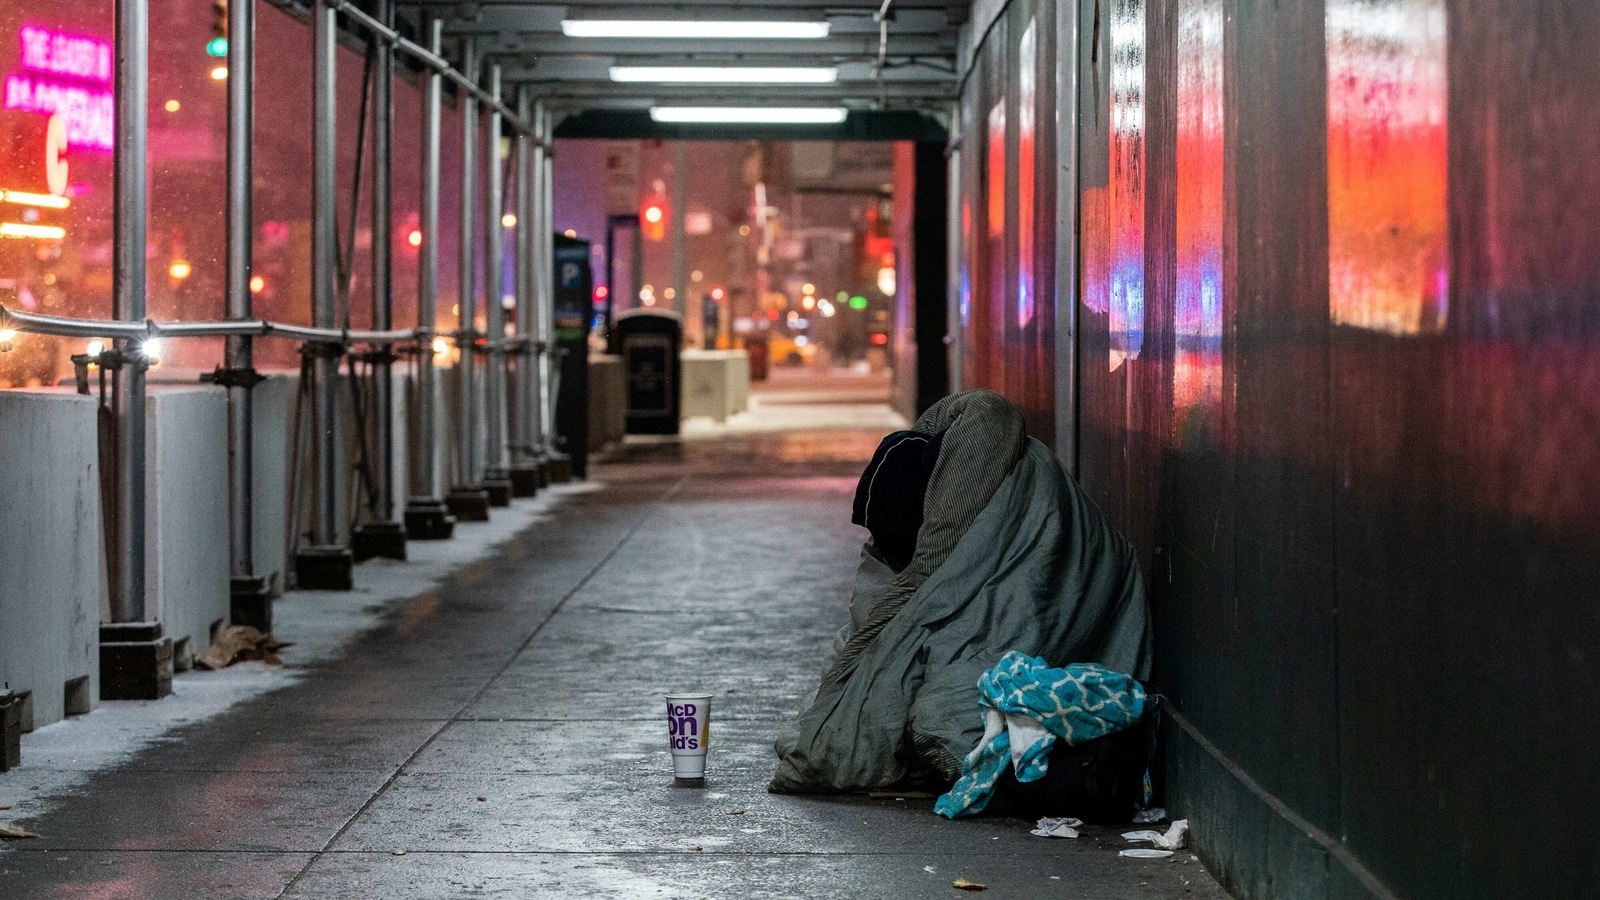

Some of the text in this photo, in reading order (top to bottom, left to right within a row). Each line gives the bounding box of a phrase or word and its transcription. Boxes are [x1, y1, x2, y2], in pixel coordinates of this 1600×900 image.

[667, 703, 697, 716] McD
[668, 716, 697, 735] on
[670, 736, 698, 750] ld's
